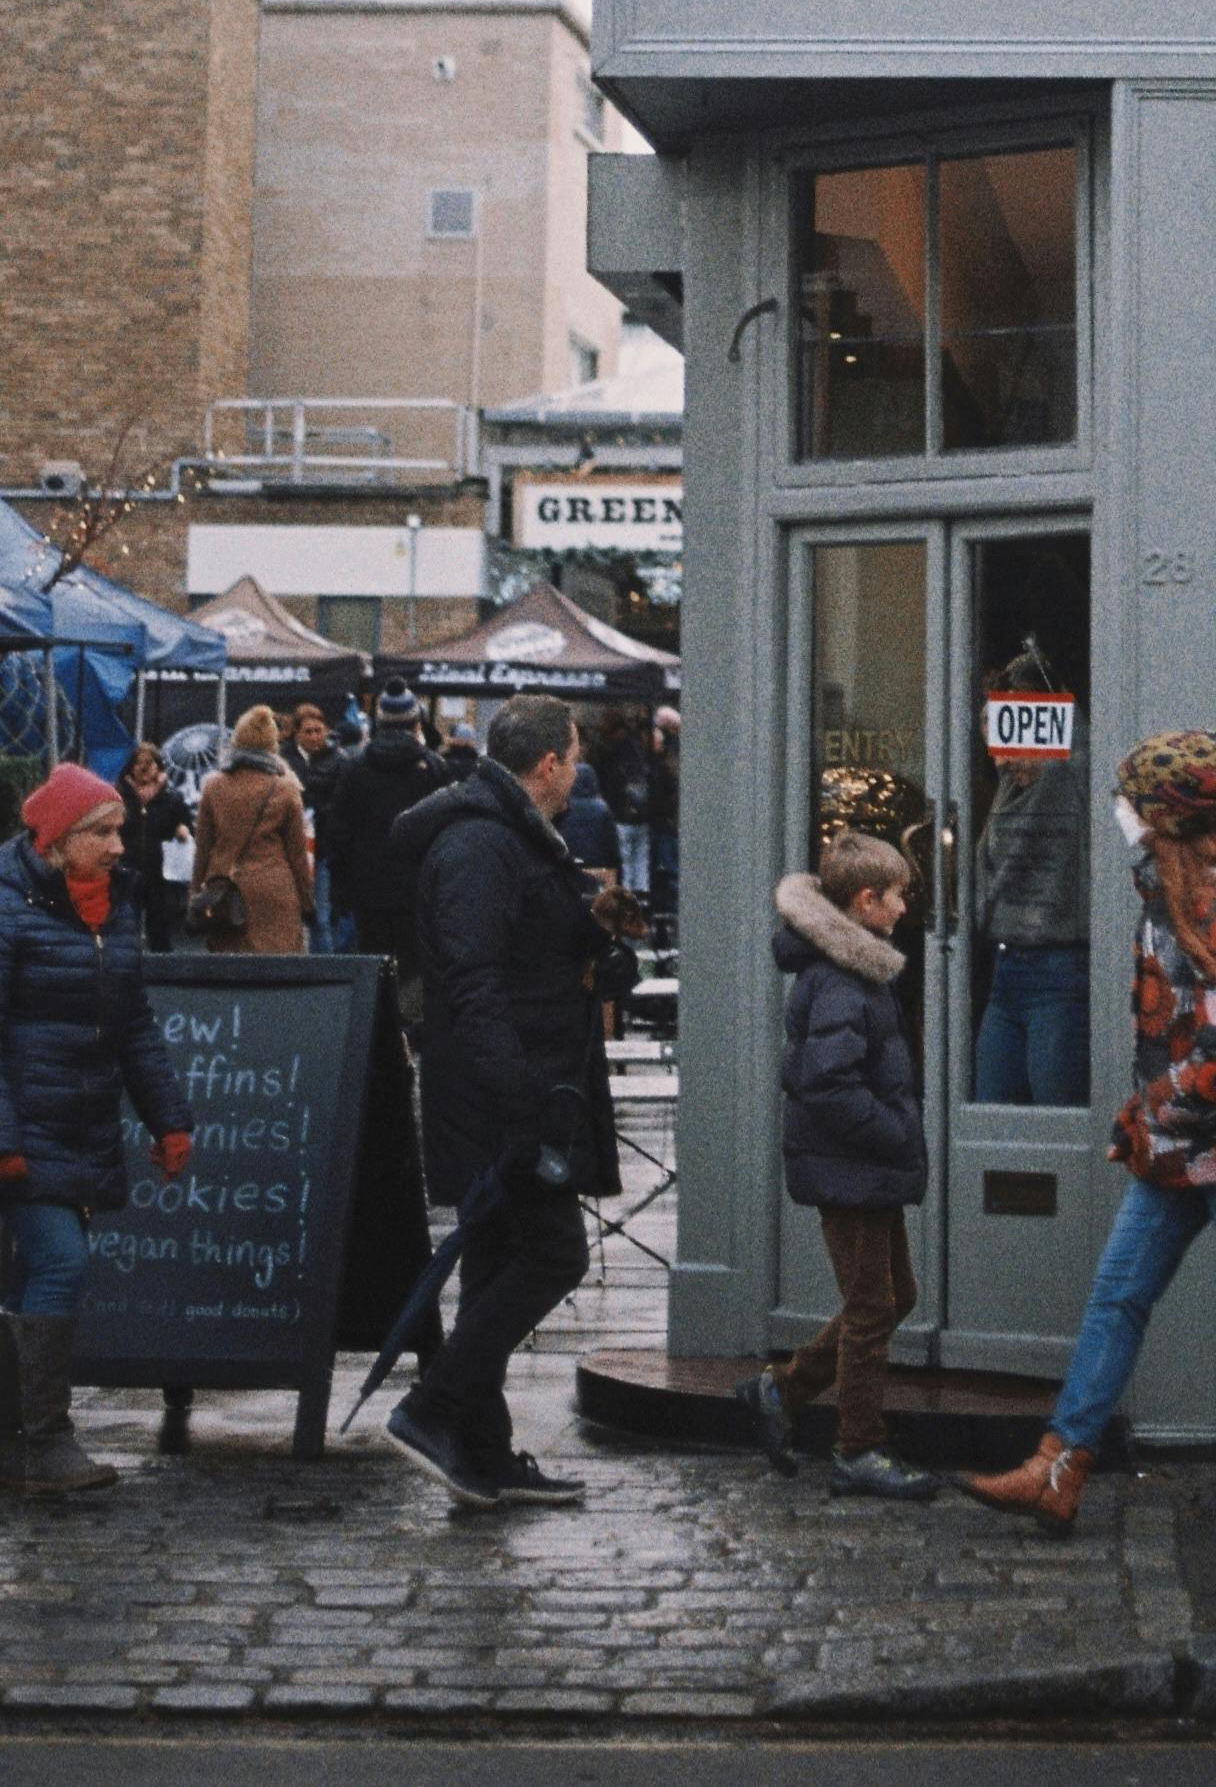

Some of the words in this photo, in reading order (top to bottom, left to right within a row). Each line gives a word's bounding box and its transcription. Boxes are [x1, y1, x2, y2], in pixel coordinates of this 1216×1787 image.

[824, 728, 914, 763] ENTRY
[997, 705, 1067, 746] OPEN
[173, 1053, 301, 1108] ffins!
[131, 1173, 311, 1225] ookies!
[191, 1228, 306, 1289] things!
